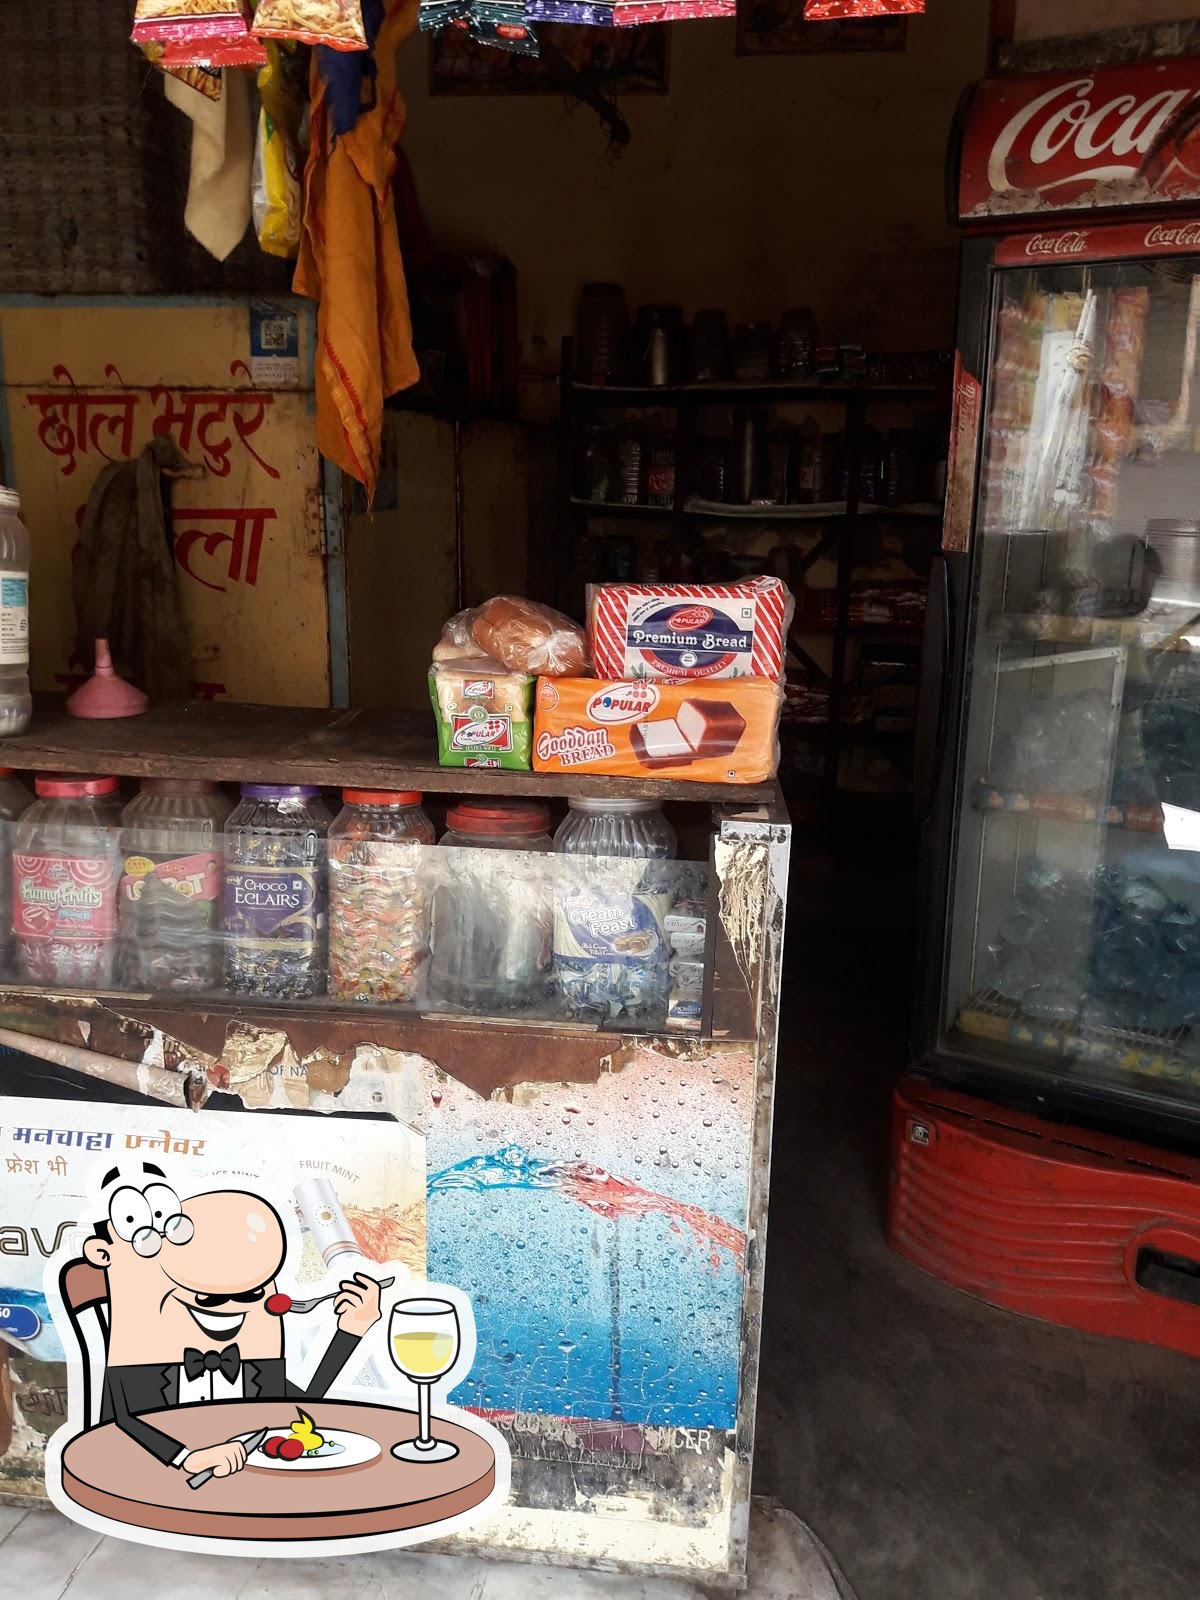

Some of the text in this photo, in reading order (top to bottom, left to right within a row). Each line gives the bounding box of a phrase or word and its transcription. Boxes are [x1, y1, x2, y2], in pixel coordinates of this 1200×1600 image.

[988, 79, 1192, 193] Coca
[1025, 231, 1089, 256] Coca-Cola
[632, 629, 747, 650] Premium Bread
[651, 659, 689, 677] PREMIUM
[693, 660, 728, 677] QUALITY
[592, 696, 651, 713] POPULAR
[460, 729, 496, 738] POPULAR
[559, 743, 615, 766] BREAD
[234, 887, 300, 908] ECLAIRS
[568, 905, 624, 926] Cream
[589, 914, 638, 938] Feast
[290, 1065, 310, 1077] NA
[13, 1126, 116, 1152] मनचाहा
[5, 1153, 70, 1176] फ्रेश भी
[298, 1159, 361, 1184] FRUIT MINT
